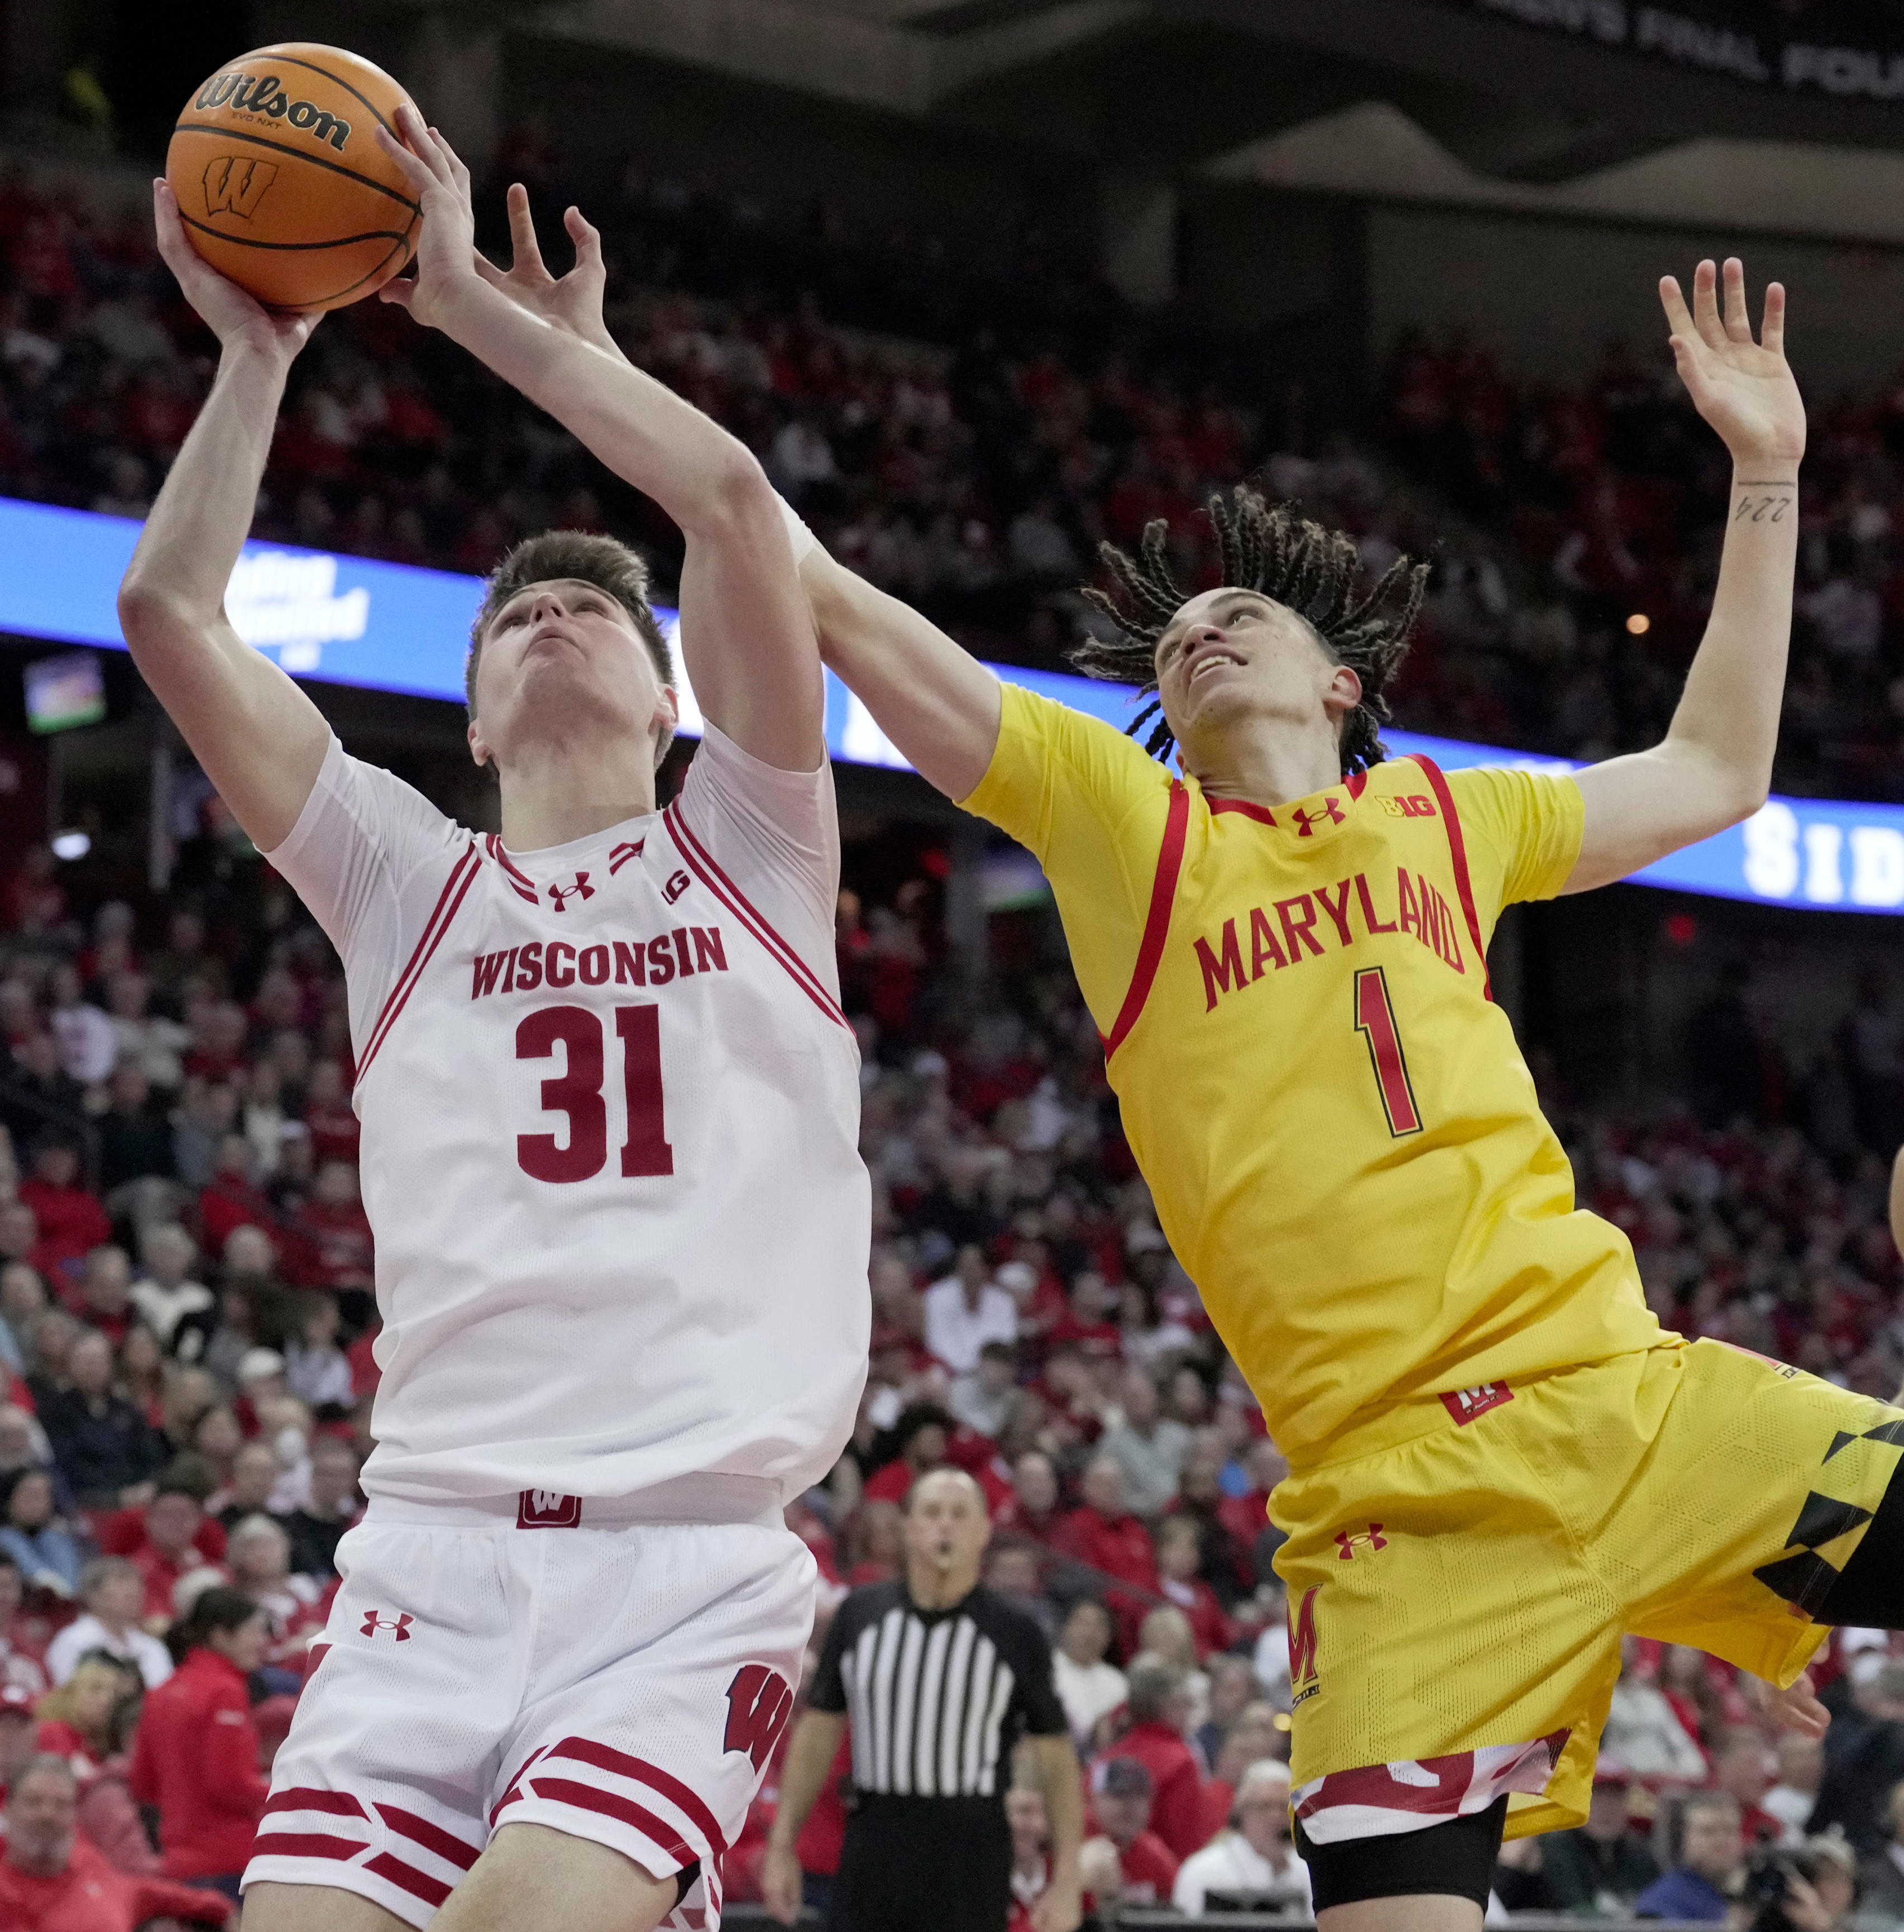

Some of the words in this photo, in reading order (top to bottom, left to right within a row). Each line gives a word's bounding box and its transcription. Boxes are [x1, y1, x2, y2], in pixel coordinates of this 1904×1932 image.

[195, 71, 351, 151] Wilson
[256, 117, 282, 130] NXT
[202, 156, 279, 219] W
[471, 927, 729, 1001] WISCONSIN
[1193, 867, 1465, 1014] MARYLAND
[515, 1003, 674, 1183] 31
[1353, 965, 1424, 1139] 1
[723, 1664, 794, 1777] W
